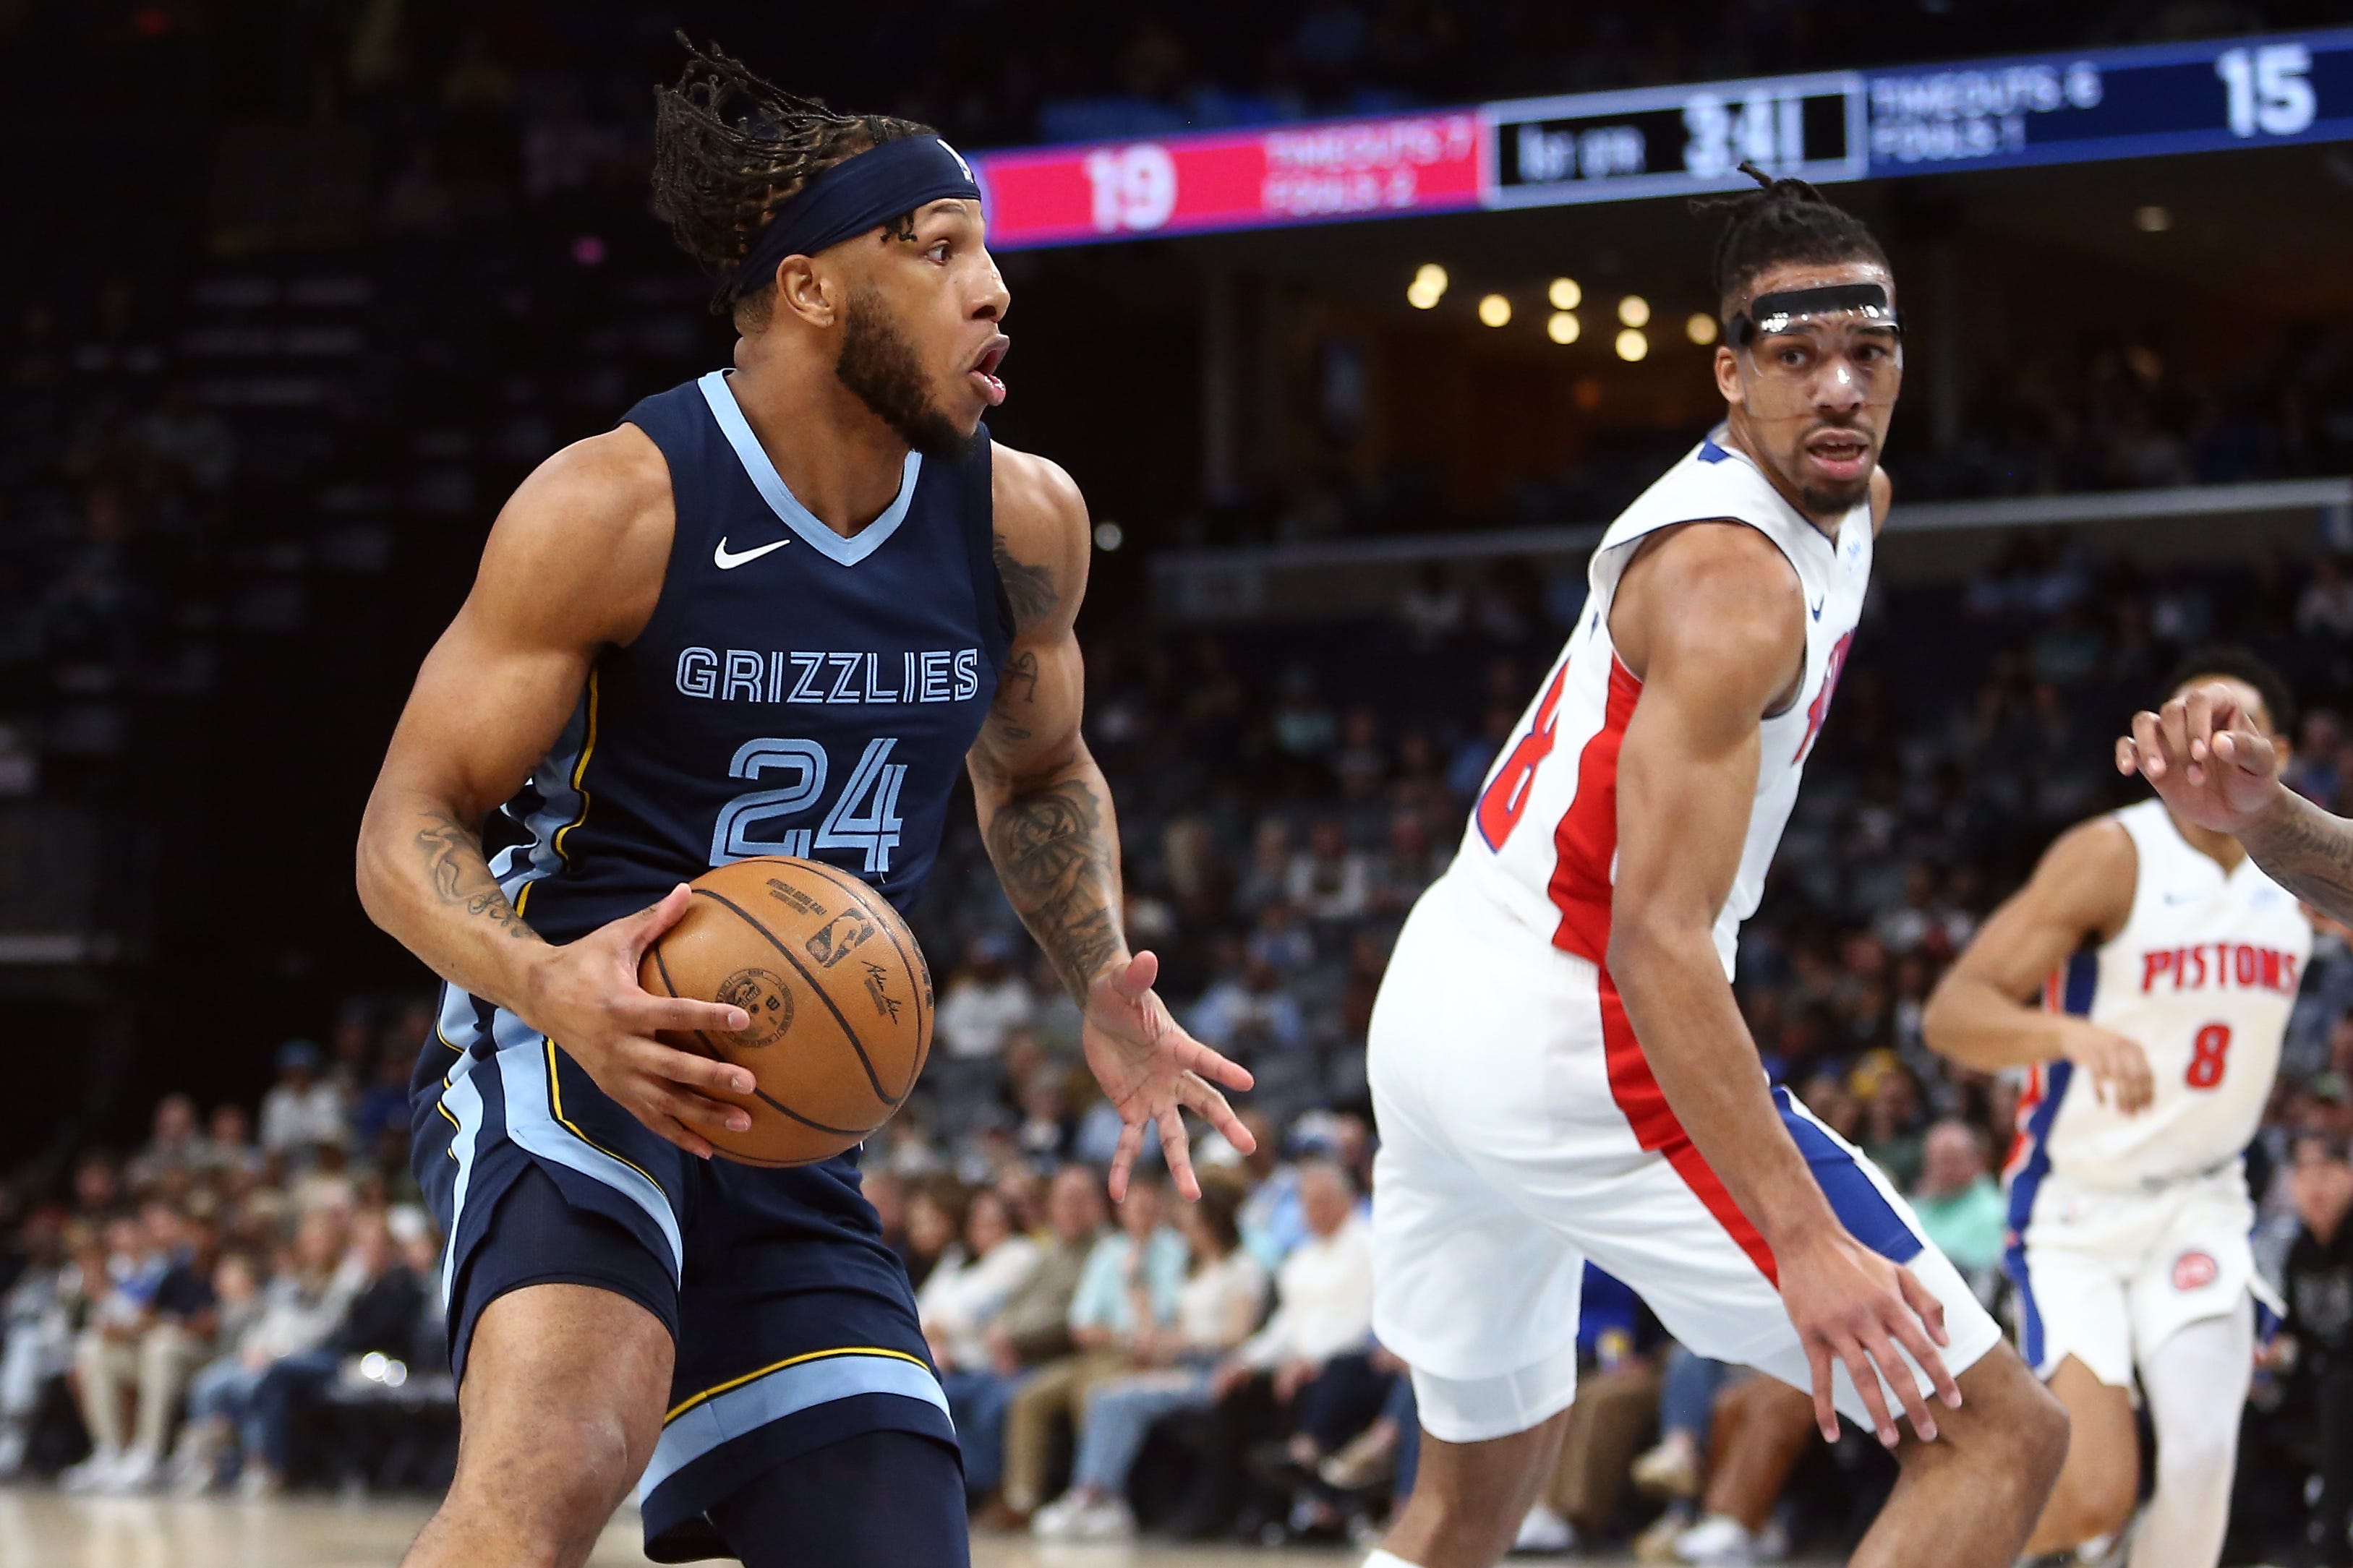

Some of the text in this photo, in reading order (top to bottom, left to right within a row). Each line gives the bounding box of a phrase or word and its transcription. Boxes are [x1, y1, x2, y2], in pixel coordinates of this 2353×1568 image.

[2216, 45, 2316, 137] 15
[1083, 146, 1177, 233] 19
[675, 646, 978, 704] GRIZZLIES
[709, 738, 908, 873] 24
[2142, 943, 2297, 995] PISTONS
[2185, 1023, 2231, 1087] 8
